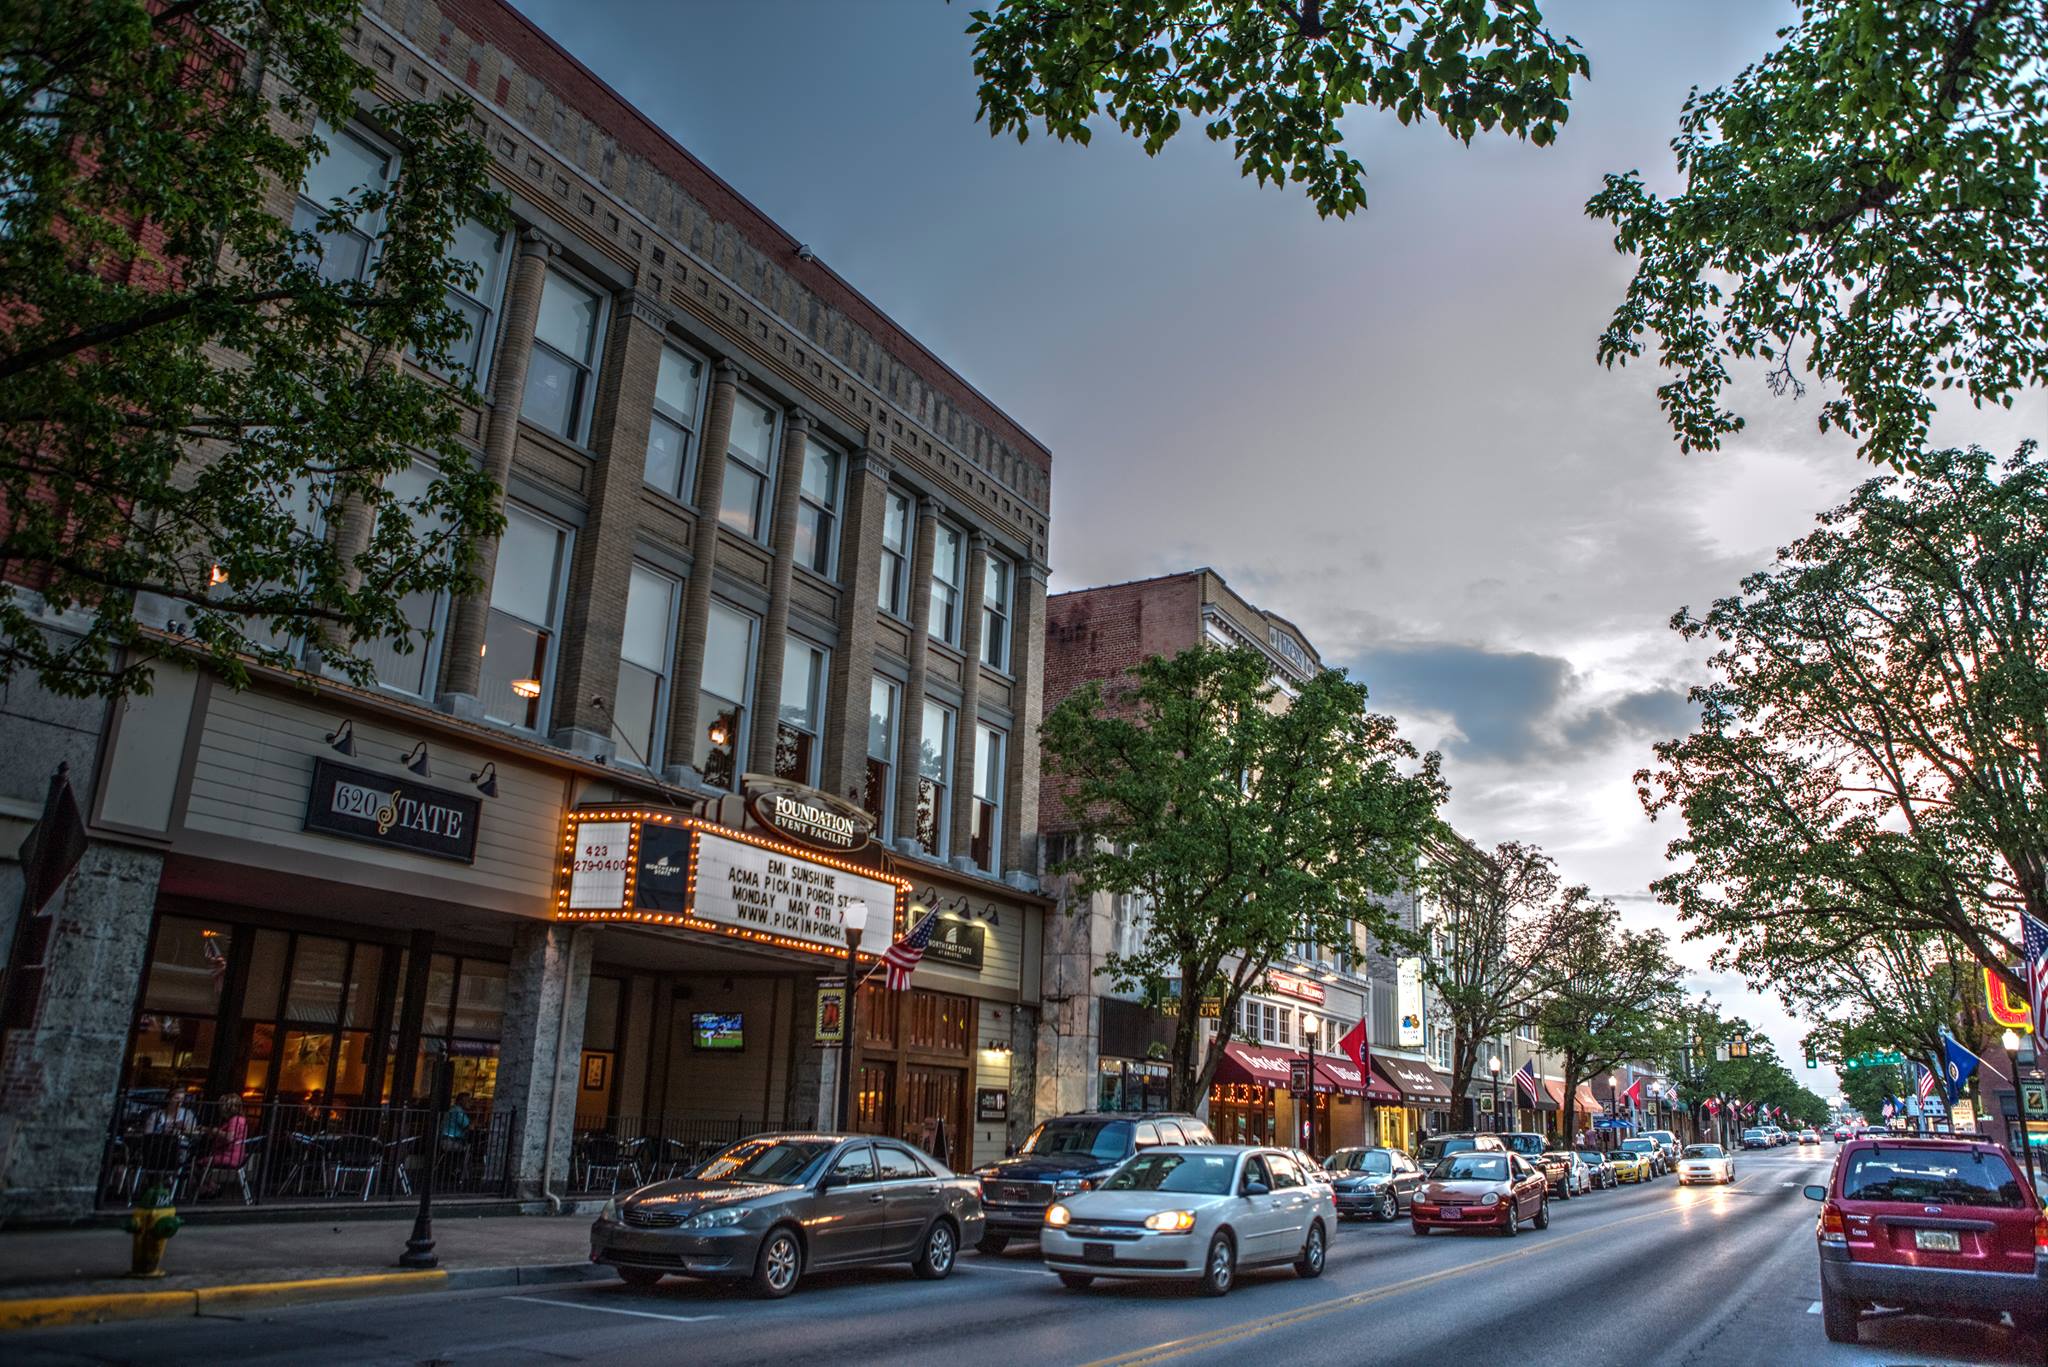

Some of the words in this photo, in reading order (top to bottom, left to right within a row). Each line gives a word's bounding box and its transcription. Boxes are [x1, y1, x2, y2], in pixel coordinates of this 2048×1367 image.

[336, 785, 378, 817] 620
[775, 796, 855, 834] FOUNDATION
[774, 815, 806, 834] EVENT
[810, 826, 854, 848] FACILITY
[574, 860, 627, 872] 279-0400
[585, 845, 609, 857] 423
[728, 867, 759, 887] ACMA
[764, 876, 802, 897] PICKIN
[807, 886, 835, 906] PORCH
[767, 859, 786, 877] EMI
[791, 866, 836, 890] SUNSHINE
[732, 885, 776, 908] MONDAY
[788, 901, 810, 919] MAY
[814, 906, 832, 922] 4TH
[928, 939, 958, 952] NORTHEAST
[958, 945, 972, 955] STATE
